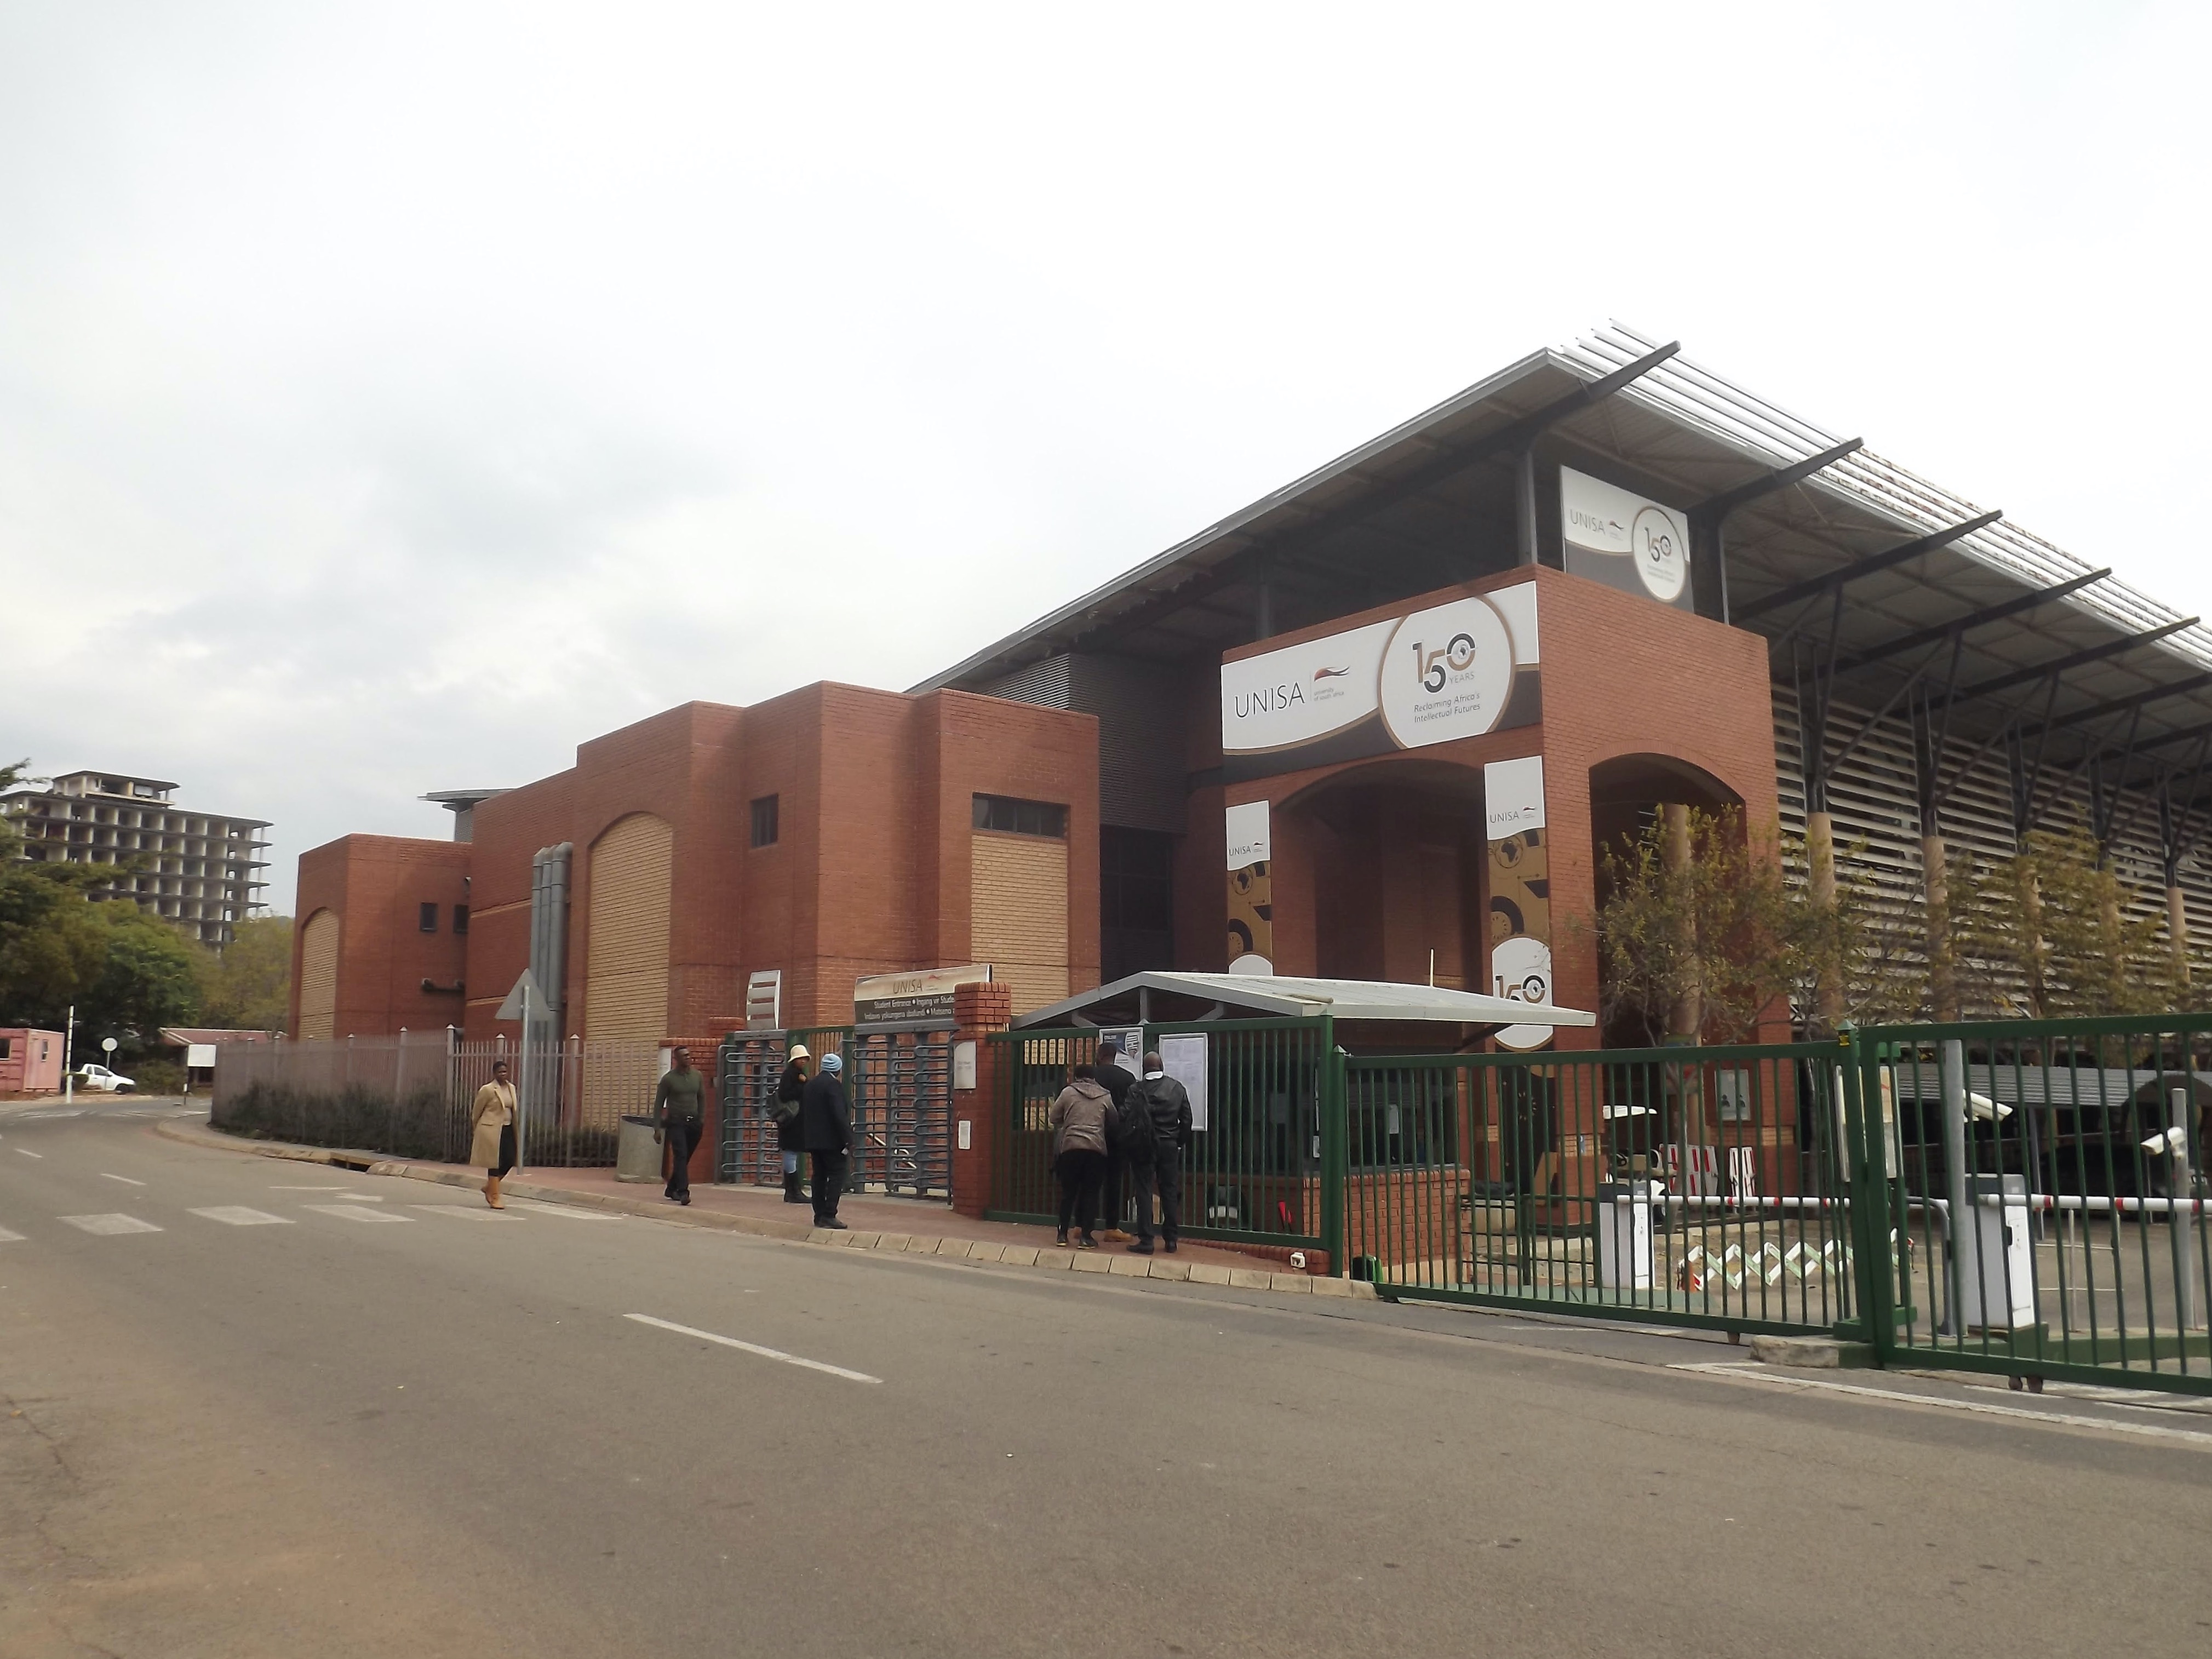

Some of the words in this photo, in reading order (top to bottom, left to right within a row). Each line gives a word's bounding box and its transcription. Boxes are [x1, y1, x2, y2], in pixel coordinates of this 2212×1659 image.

[1570, 509, 1606, 535] UNISA
[1643, 526, 1671, 562] 150
[1412, 633, 1476, 693] 150
[1449, 672, 1475, 684] YEARS
[1235, 682, 1305, 718] UNISA
[1414, 699, 1452, 712] Reclaiming
[1454, 693, 1480, 704] Africa's
[1414, 710, 1452, 723] Intellectual
[1454, 703, 1480, 715] Futures
[1490, 811, 1519, 823] UNISA
[1229, 845, 1251, 856] UNISA
[893, 979, 923, 994] UNISA
